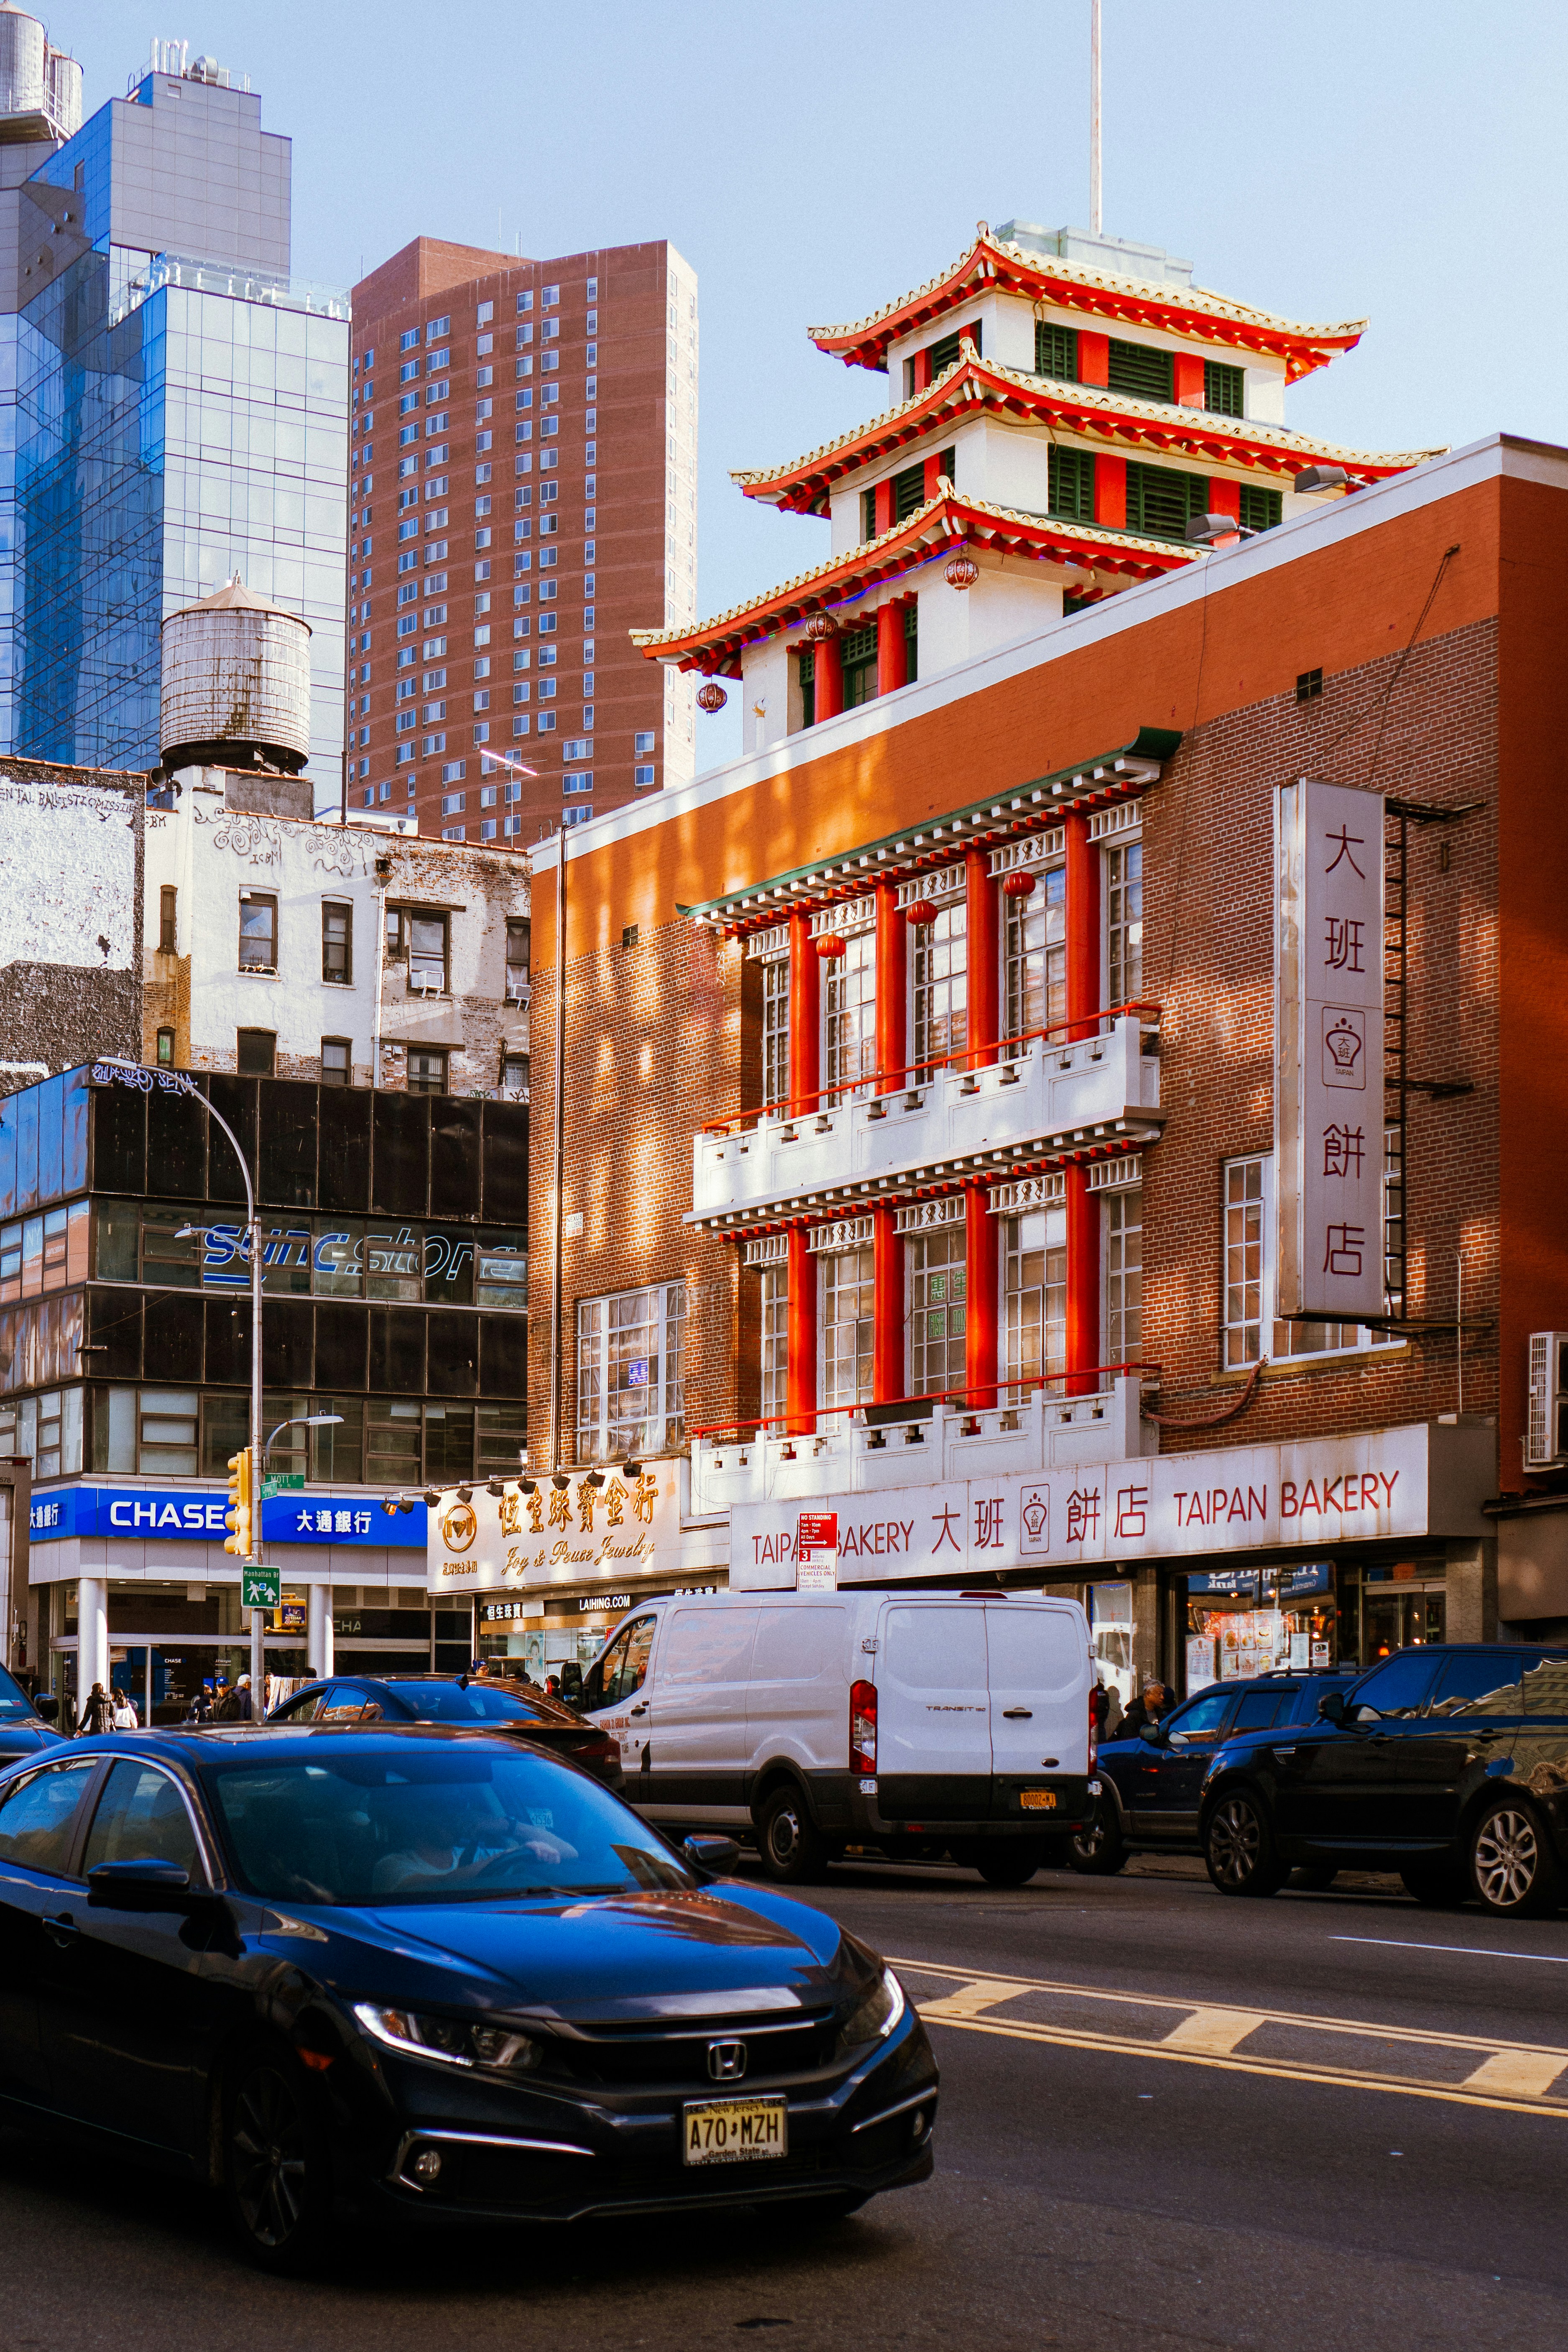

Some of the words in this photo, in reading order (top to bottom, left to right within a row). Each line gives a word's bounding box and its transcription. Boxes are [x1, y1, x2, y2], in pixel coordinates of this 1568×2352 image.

[250, 850, 278, 865] ICBM
[271, 1475, 289, 1484] MOTT
[262, 1484, 273, 1494] CANAL
[1173, 1484, 1267, 1527] TAIPAN
[1282, 1470, 1399, 1518] BAKERY
[110, 1501, 226, 1529] CHASE
[296, 1509, 372, 1534] 大通銀行
[501, 1546, 529, 1576] Joy
[533, 1549, 546, 1567] &
[549, 1540, 593, 1565] Peace
[593, 1532, 655, 1565] Jewelry
[802, 1550, 808, 1561] 3
[580, 1595, 630, 1611] LAIHING.COM
[710, 2106, 731, 2115] New
[732, 2103, 761, 2115] Jersey
[708, 2149, 737, 2159] Garden
[739, 2147, 760, 2156] State
